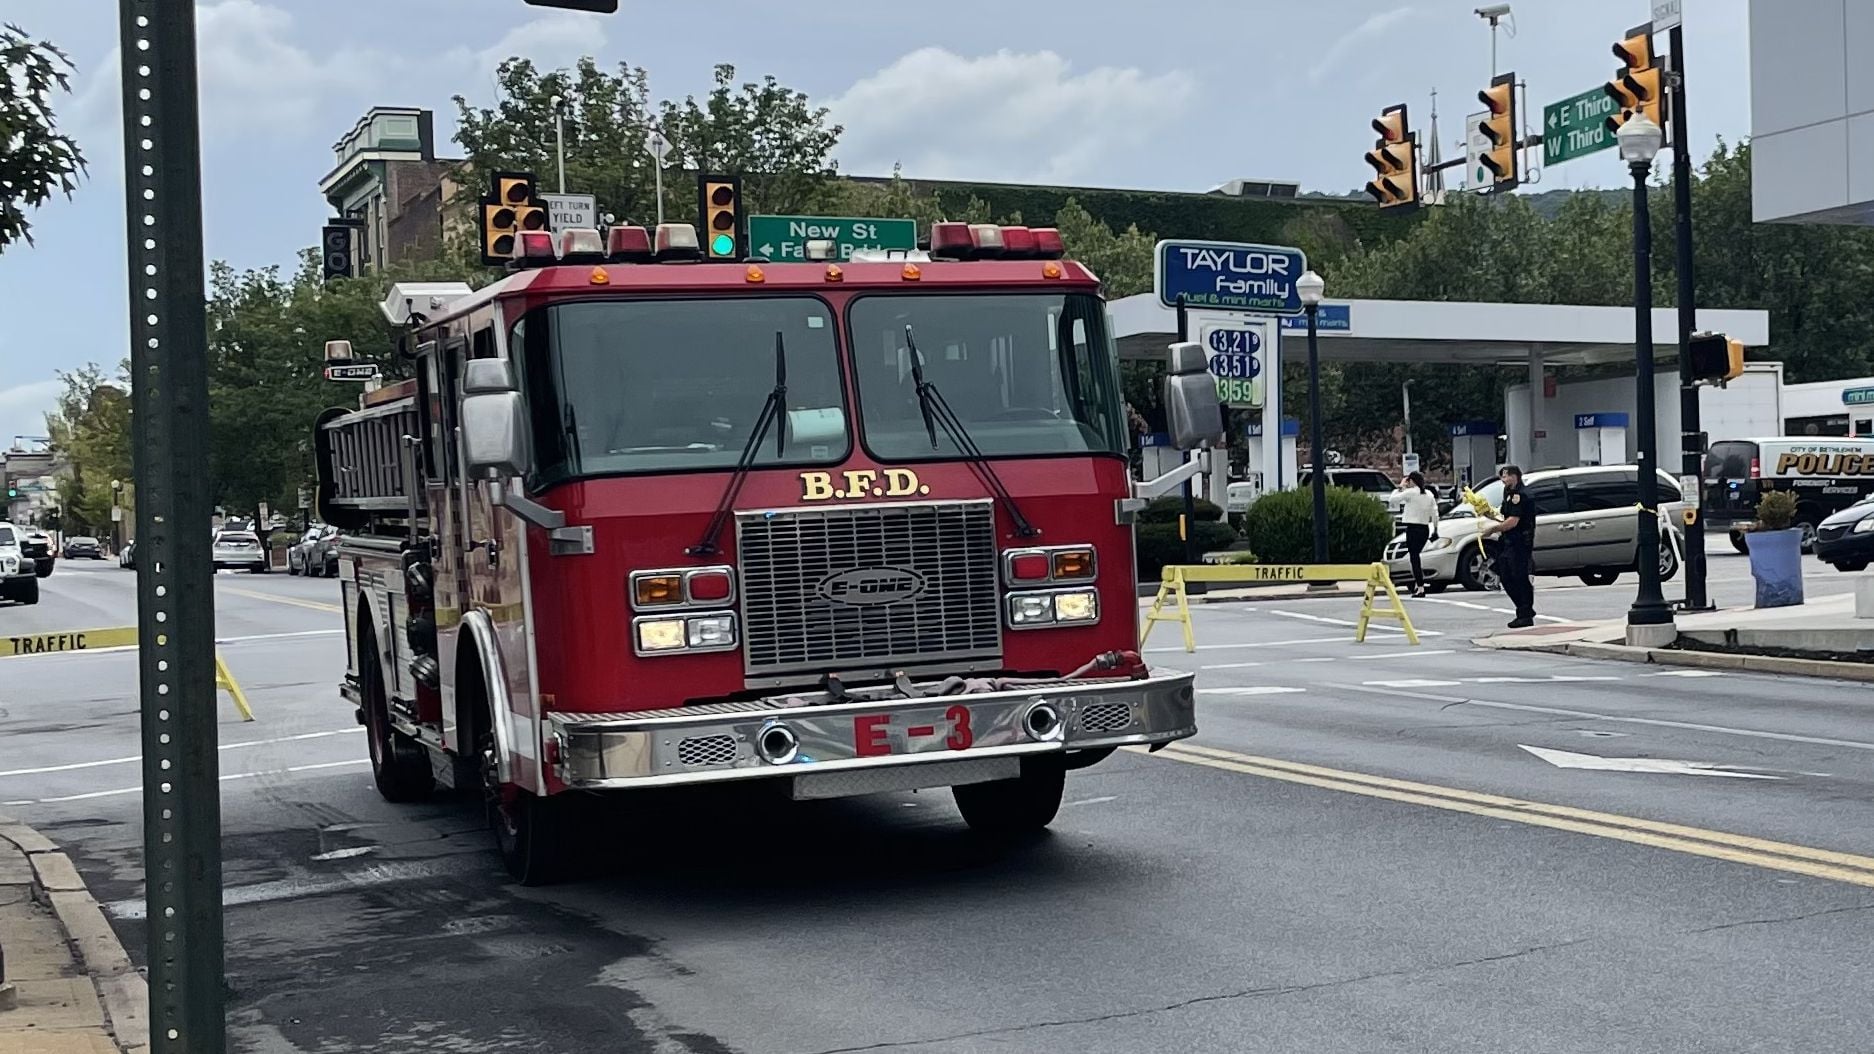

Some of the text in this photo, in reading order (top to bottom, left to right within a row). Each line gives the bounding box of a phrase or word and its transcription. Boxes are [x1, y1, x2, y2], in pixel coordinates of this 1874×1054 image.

[1560, 95, 1611, 127] E Third
[1547, 121, 1604, 158] W Third
[568, 202, 590, 211] TURN
[553, 213, 583, 224] YIELD
[789, 221, 877, 240] New St
[1180, 248, 1290, 276] TAYLOR
[1209, 293, 1219, 304] &
[1222, 295, 1247, 305] mini
[1248, 297, 1286, 308] marts
[1776, 453, 1874, 476] POLICE
[800, 468, 930, 500] B.F.D.
[1255, 567, 1304, 579] TRAFFIC
[831, 577, 912, 595] E-ONE
[10, 634, 86, 655] TRAFFIC
